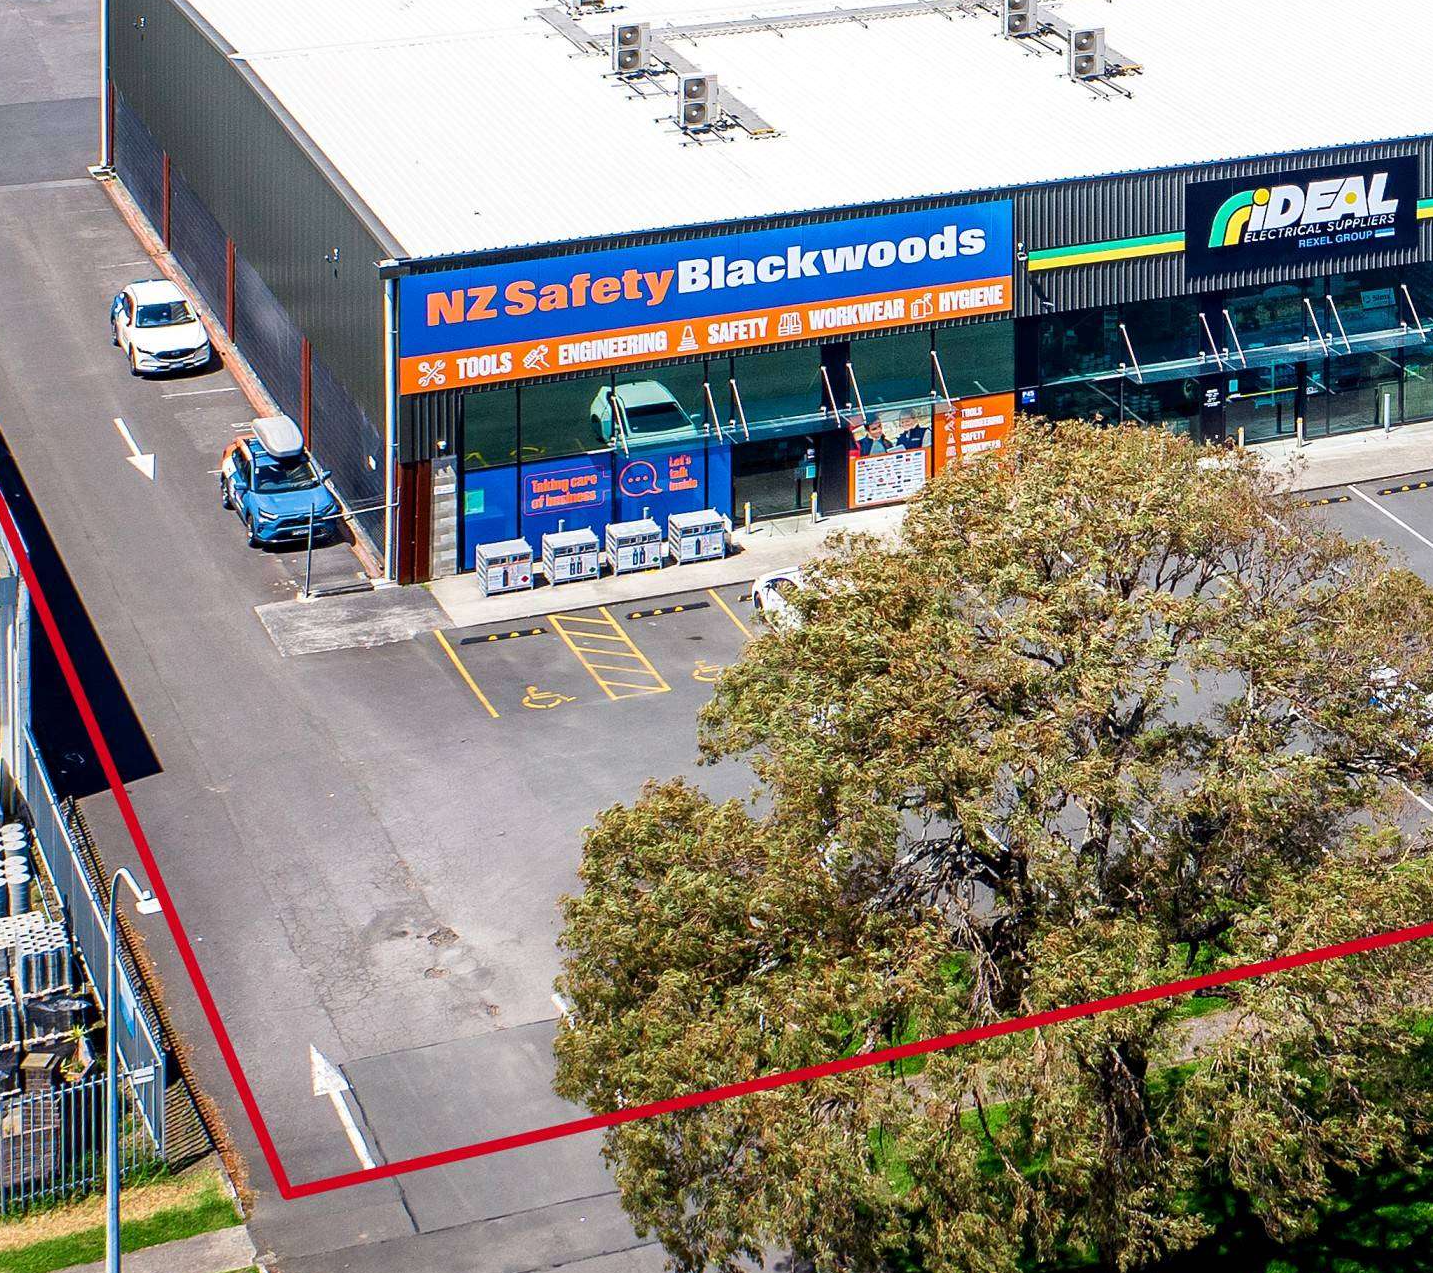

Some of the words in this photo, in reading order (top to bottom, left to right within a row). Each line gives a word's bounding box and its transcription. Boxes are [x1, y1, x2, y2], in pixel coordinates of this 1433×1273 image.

[1244, 225, 1321, 244] ELECTRICAL
[1327, 213, 1395, 232] SUPPLIERS
[1298, 236, 1333, 248] REXEL
[1335, 230, 1373, 243] GROUP
[427, 286, 497, 326] NZ
[457, 352, 512, 379] TOOLS
[558, 331, 667, 365] ENGINEERING
[707, 317, 768, 344] SAFETY
[809, 298, 905, 330] WORKWEAR
[939, 285, 1003, 312] HYGIENE
[961, 430, 986, 443] SAFETY
[531, 478, 569, 494] Taking
[570, 474, 598, 488] care
[531, 496, 545, 510] of
[545, 490, 597, 507] business
